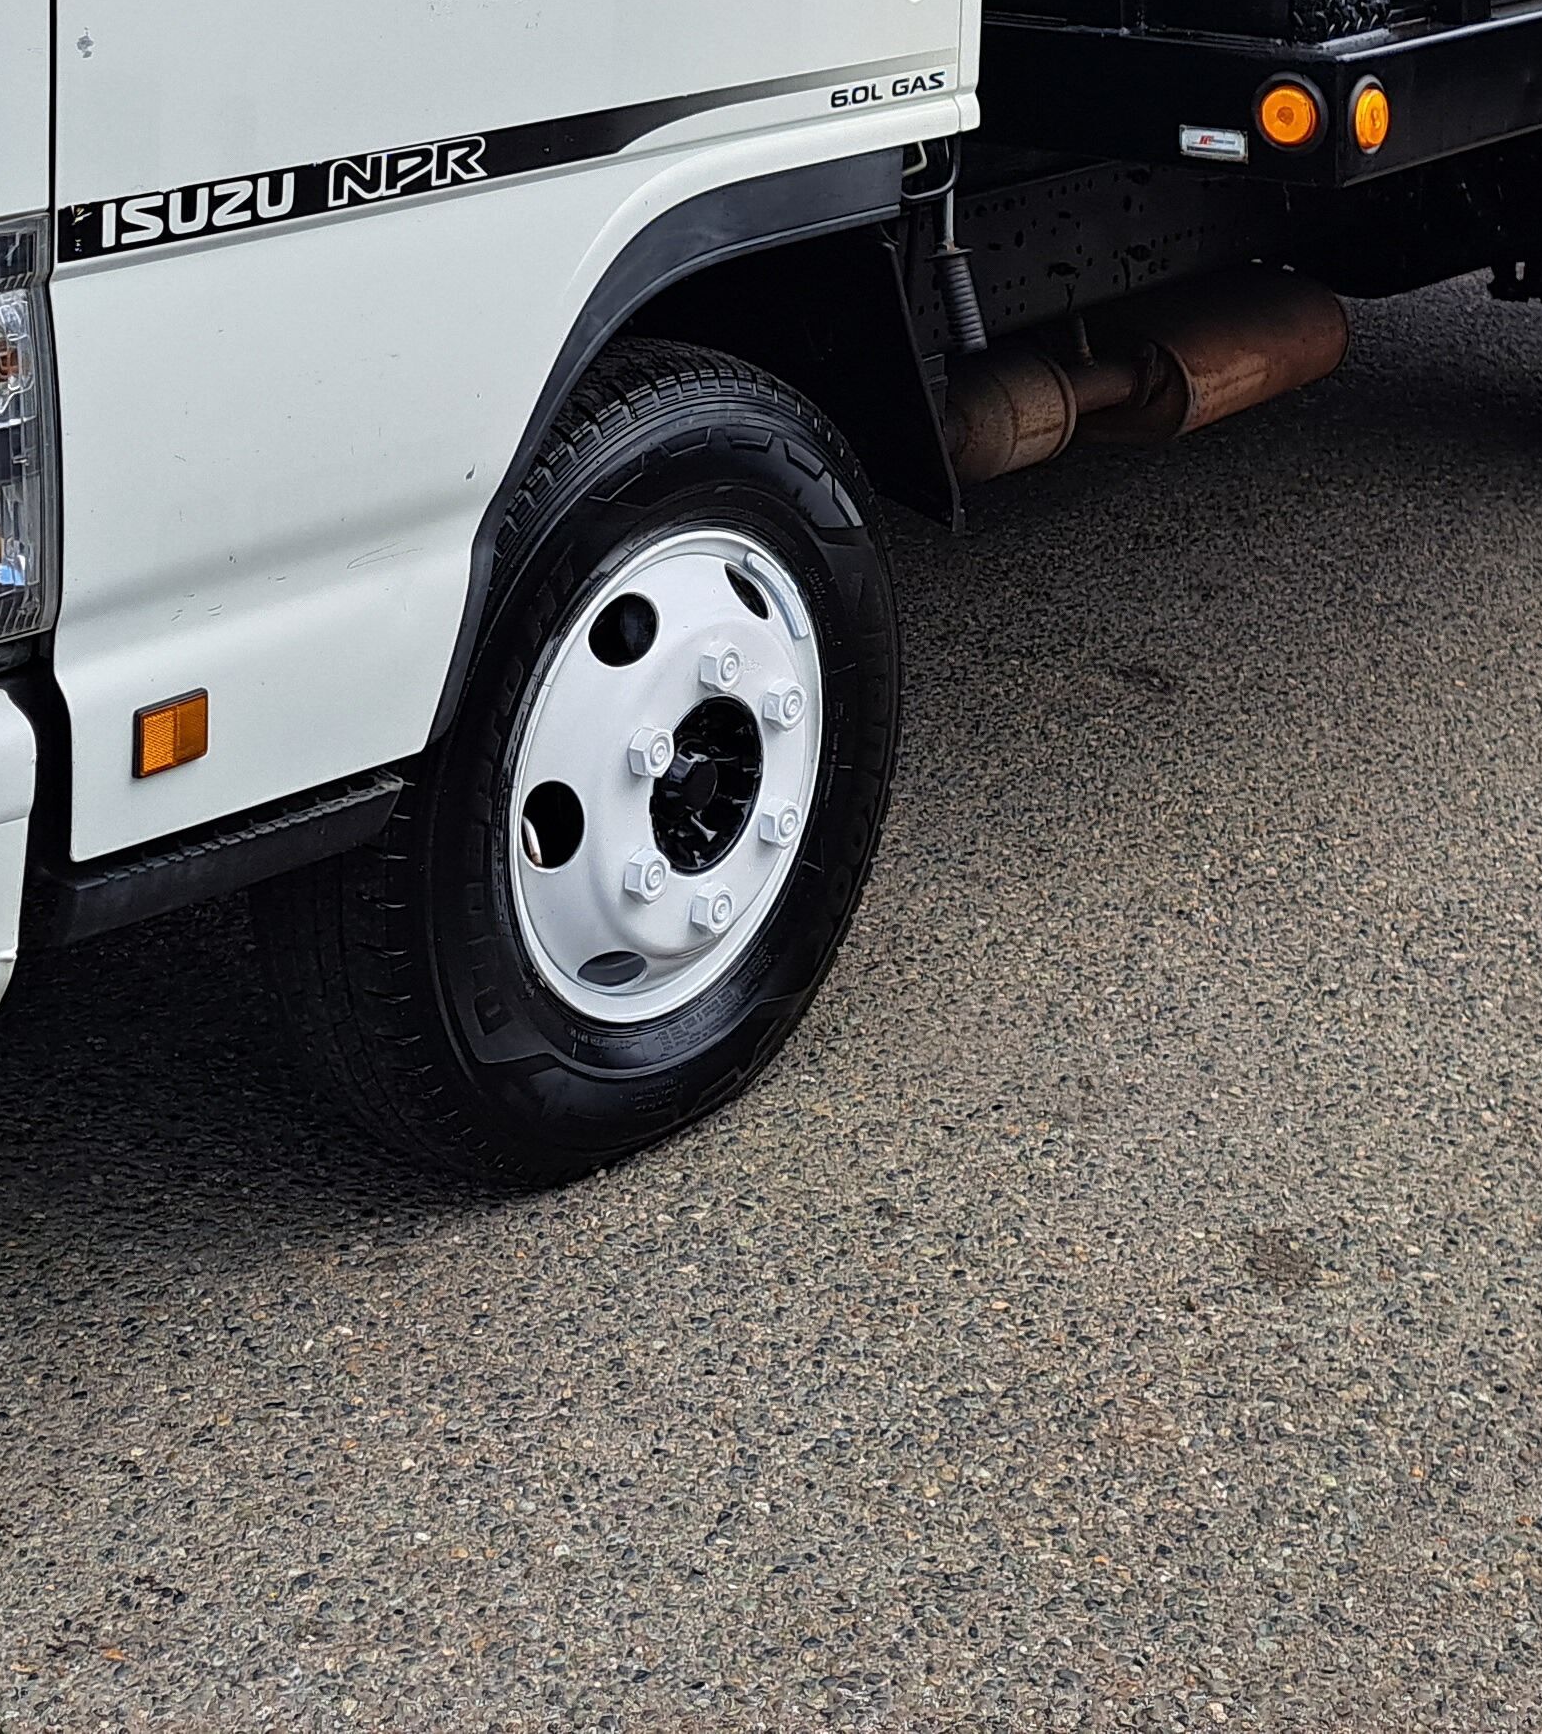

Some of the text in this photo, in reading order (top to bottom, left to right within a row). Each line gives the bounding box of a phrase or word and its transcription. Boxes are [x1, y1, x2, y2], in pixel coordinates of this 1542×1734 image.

[830, 71, 945, 108] 6.0L GAS
[101, 134, 487, 248] ISUZU NPR
